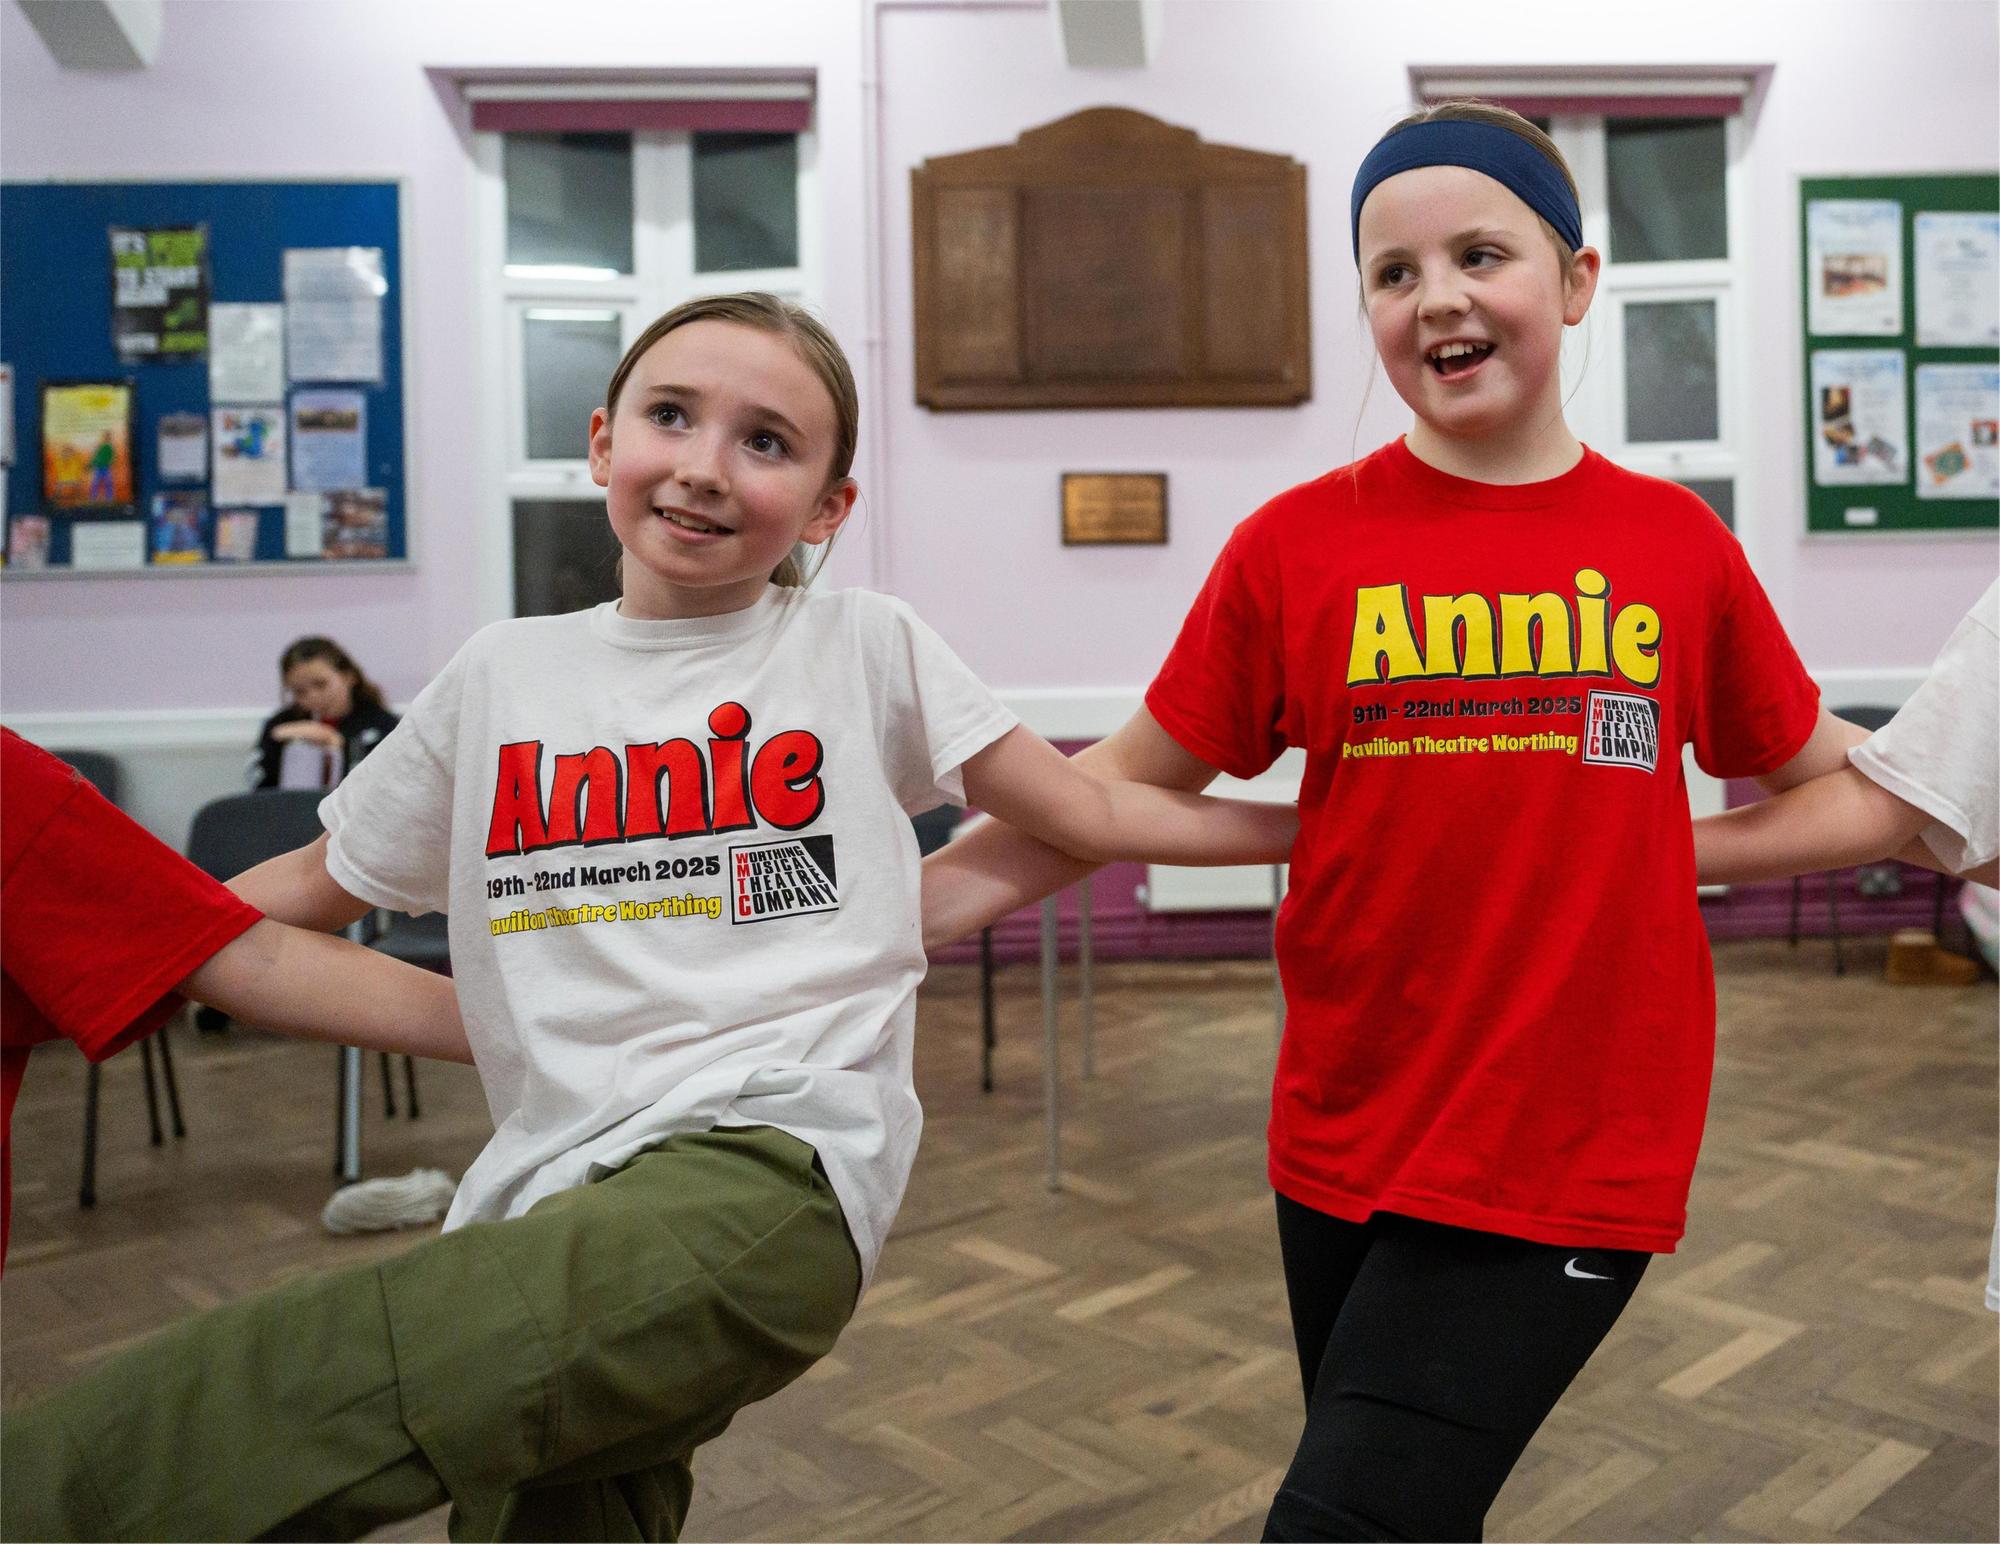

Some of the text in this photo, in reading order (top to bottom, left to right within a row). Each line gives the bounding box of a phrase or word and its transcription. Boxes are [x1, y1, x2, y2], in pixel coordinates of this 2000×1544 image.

[1346, 568, 1663, 689] Annie
[1403, 698, 1456, 719] 22nd
[1459, 697, 1525, 717] March
[1527, 696, 1582, 717] 2025
[1592, 708, 1654, 729] MUSICAL
[1593, 698, 1650, 715] WORTHING
[1342, 730, 1578, 760] Pavilion Theatre Worthing
[1591, 720, 1656, 746] THEATRE
[485, 701, 825, 859] Annie
[735, 845, 804, 864] WORTHING
[737, 855, 814, 878] MUSICAL
[486, 874, 525, 899] 19th
[534, 866, 576, 892] 22nd
[580, 861, 651, 886] March
[655, 855, 721, 880] 2025
[737, 868, 825, 895] THEATRE
[738, 883, 839, 917] COMPANY
[489, 908, 547, 936] avilion
[618, 892, 722, 921] Worthing
